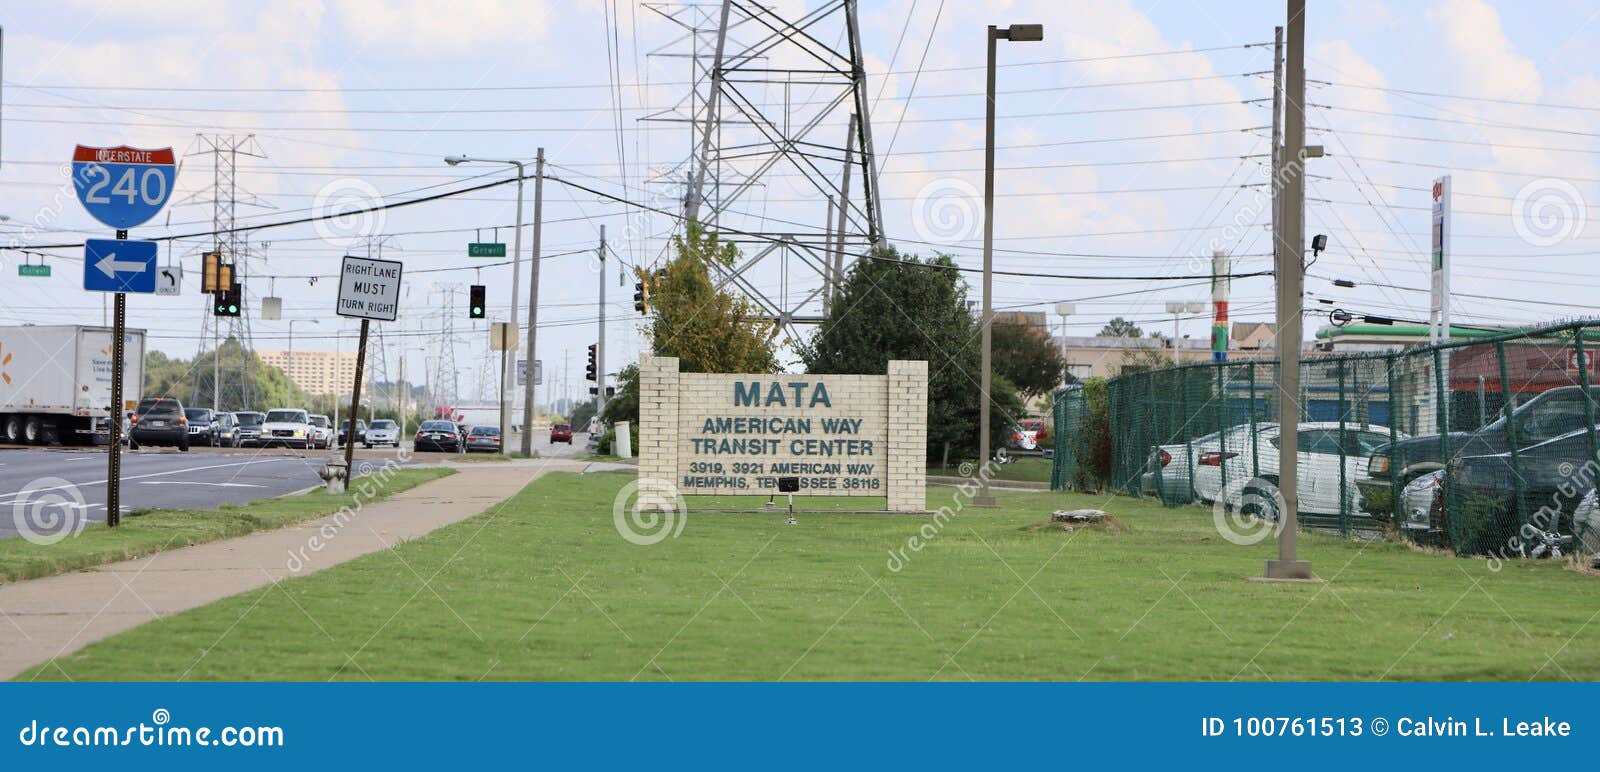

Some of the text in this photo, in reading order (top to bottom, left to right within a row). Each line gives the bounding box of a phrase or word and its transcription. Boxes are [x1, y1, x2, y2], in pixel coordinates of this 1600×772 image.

[95, 150, 153, 163] INTERSTATE
[85, 164, 167, 206] 240
[346, 264, 398, 279] RIGHT LANE
[353, 281, 386, 296] MUST
[341, 298, 394, 313] TURN RIGHT
[734, 381, 832, 408] MATA
[702, 417, 863, 435] AMERICAN WAY
[691, 438, 873, 456] TRANSIT CENTER
[689, 462, 875, 475] 3919, 3921 AMERICAN WAY
[683, 476, 880, 490] MEMPHIS, TENSSEE 38118
